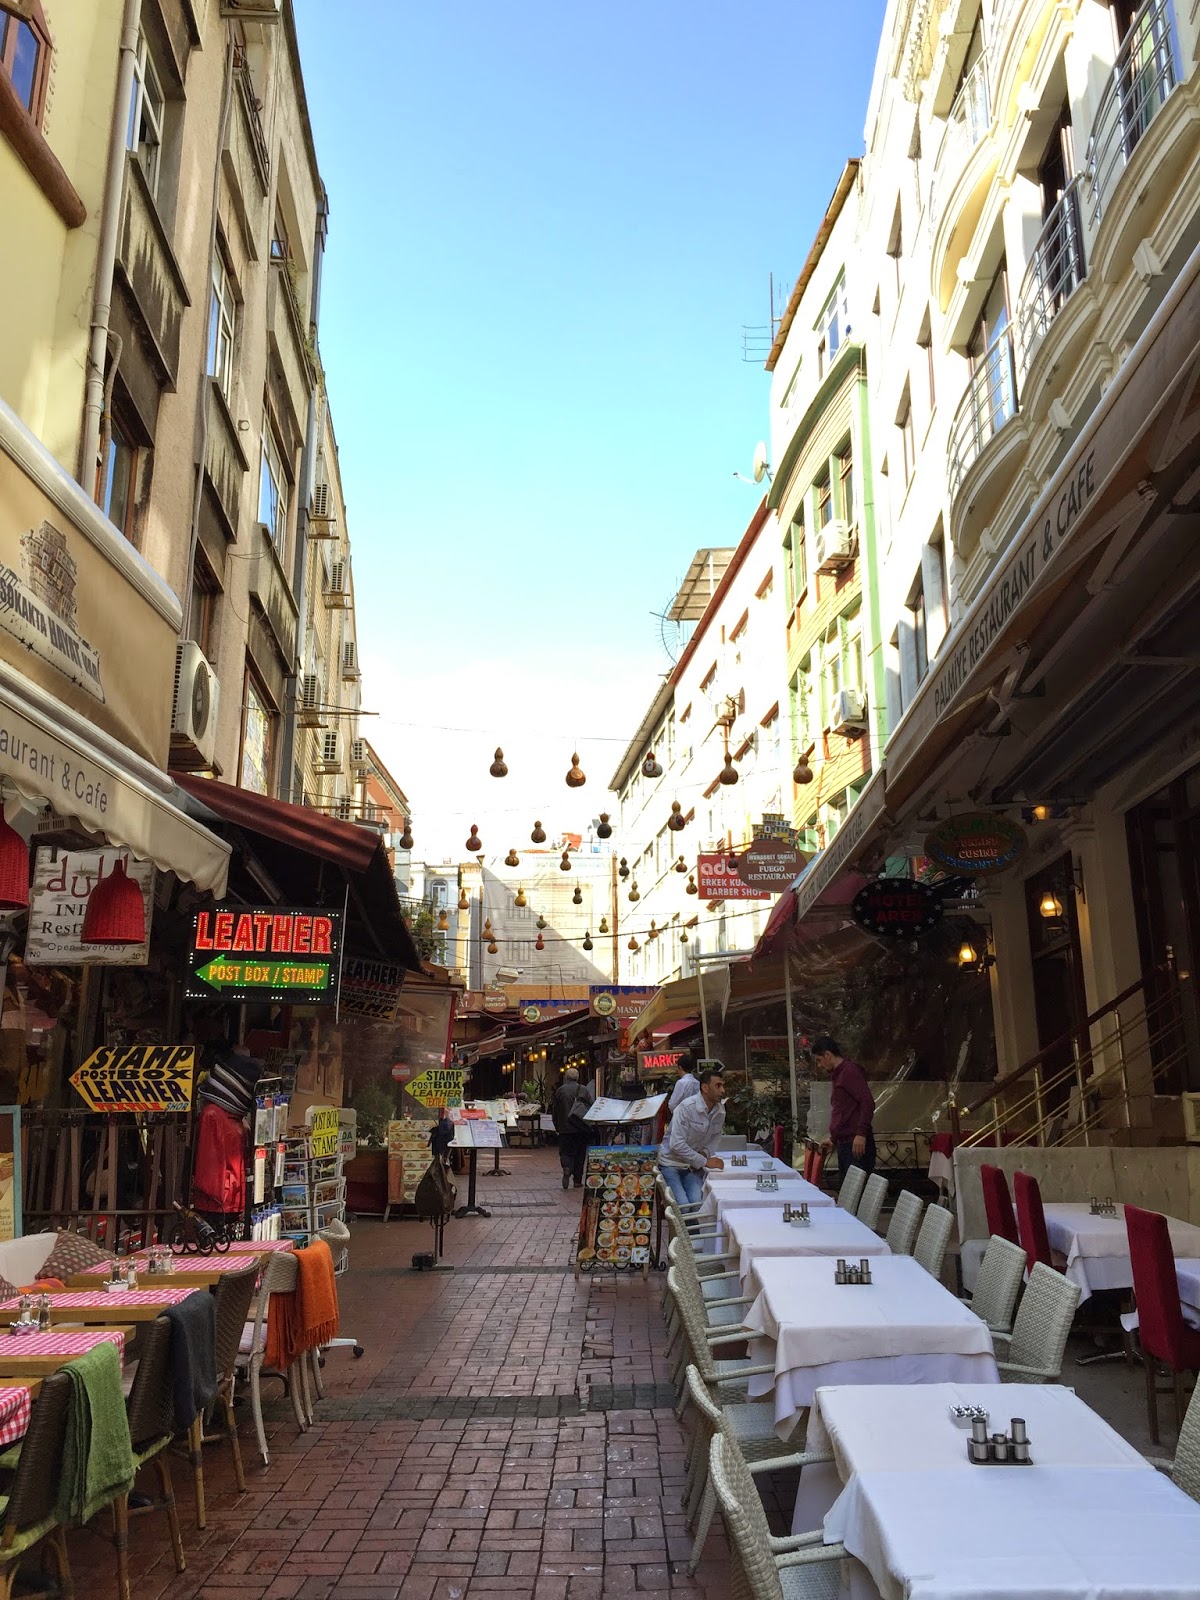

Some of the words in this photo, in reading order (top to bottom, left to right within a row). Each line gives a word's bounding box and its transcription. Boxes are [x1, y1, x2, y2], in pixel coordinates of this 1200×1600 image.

[970, 541, 1037, 668] RESTAURANT
[1043, 519, 1054, 561] &
[1057, 451, 1095, 537] CAFE
[48, 616, 83, 669] HAYAT
[0, 728, 55, 782] aurant
[62, 761, 71, 791] &
[75, 771, 108, 813] Cafe
[707, 888, 739, 896] BARBER
[195, 912, 333, 954] LEATHER
[209, 965, 241, 981] POST
[244, 966, 270, 982] BOX
[273, 967, 280, 984] /
[282, 968, 324, 984] STAMP
[89, 1046, 194, 1069] STAMP
[426, 1070, 462, 1081] STAMP
[81, 1080, 190, 1102] LEATHER
[447, 1098, 462, 1106] SHOP
[312, 1135, 338, 1155] STAMP
